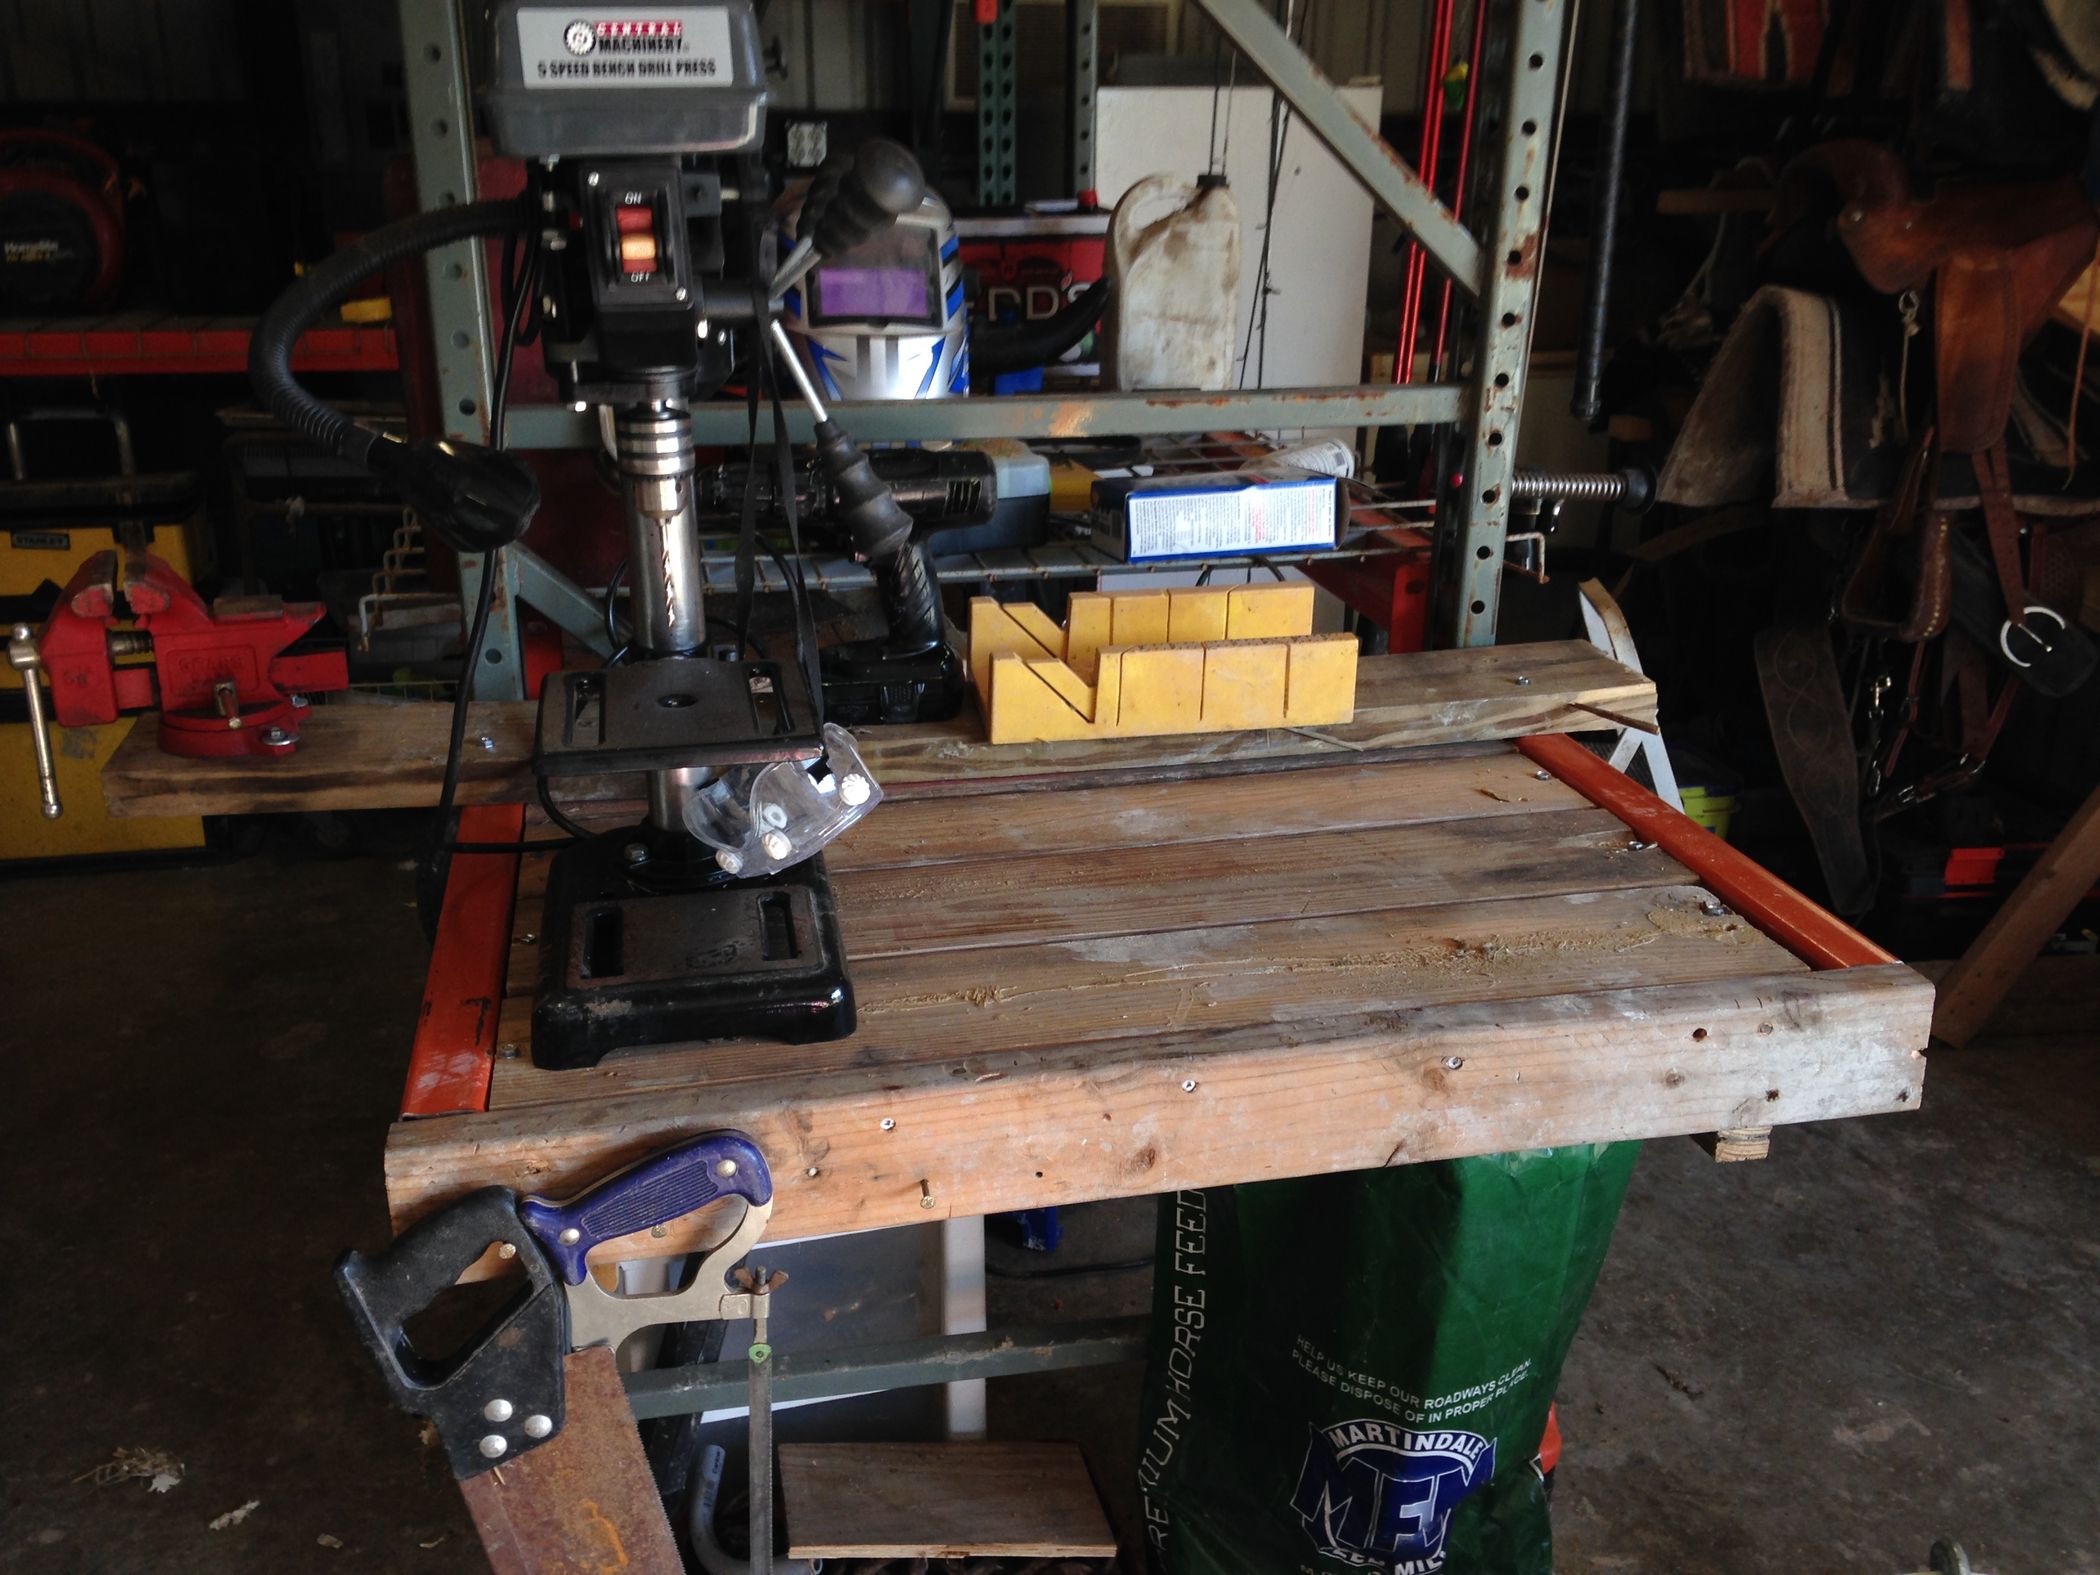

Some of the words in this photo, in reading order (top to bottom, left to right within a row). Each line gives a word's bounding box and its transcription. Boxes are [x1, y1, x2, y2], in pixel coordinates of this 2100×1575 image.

[599, 37, 682, 53] MACHINERY
[549, 60, 589, 78] SPEED
[593, 59, 635, 78] BENCH
[638, 59, 672, 77] DRILL
[676, 58, 716, 77] PRESS
[624, 191, 642, 204] ON
[630, 271, 650, 283] OFF
[1176, 1190, 1207, 1276] FEED
[1166, 1285, 1206, 1401] HORSE
[1292, 1349, 1336, 1386] PLEASE
[1340, 1381, 1401, 1415] DISPOSE
[1405, 1408, 1425, 1424] OF
[1428, 1412, 1442, 1424] IN
[1445, 1395, 1493, 1420] PROPER
[1297, 1334, 1324, 1362] HELP
[1327, 1359, 1344, 1377] US
[1348, 1371, 1386, 1391] KEEP
[1390, 1385, 1420, 1409] OUR
[1424, 1380, 1496, 1410] ROADWAYS
[1328, 1422, 1484, 1461] MARTINDALE
